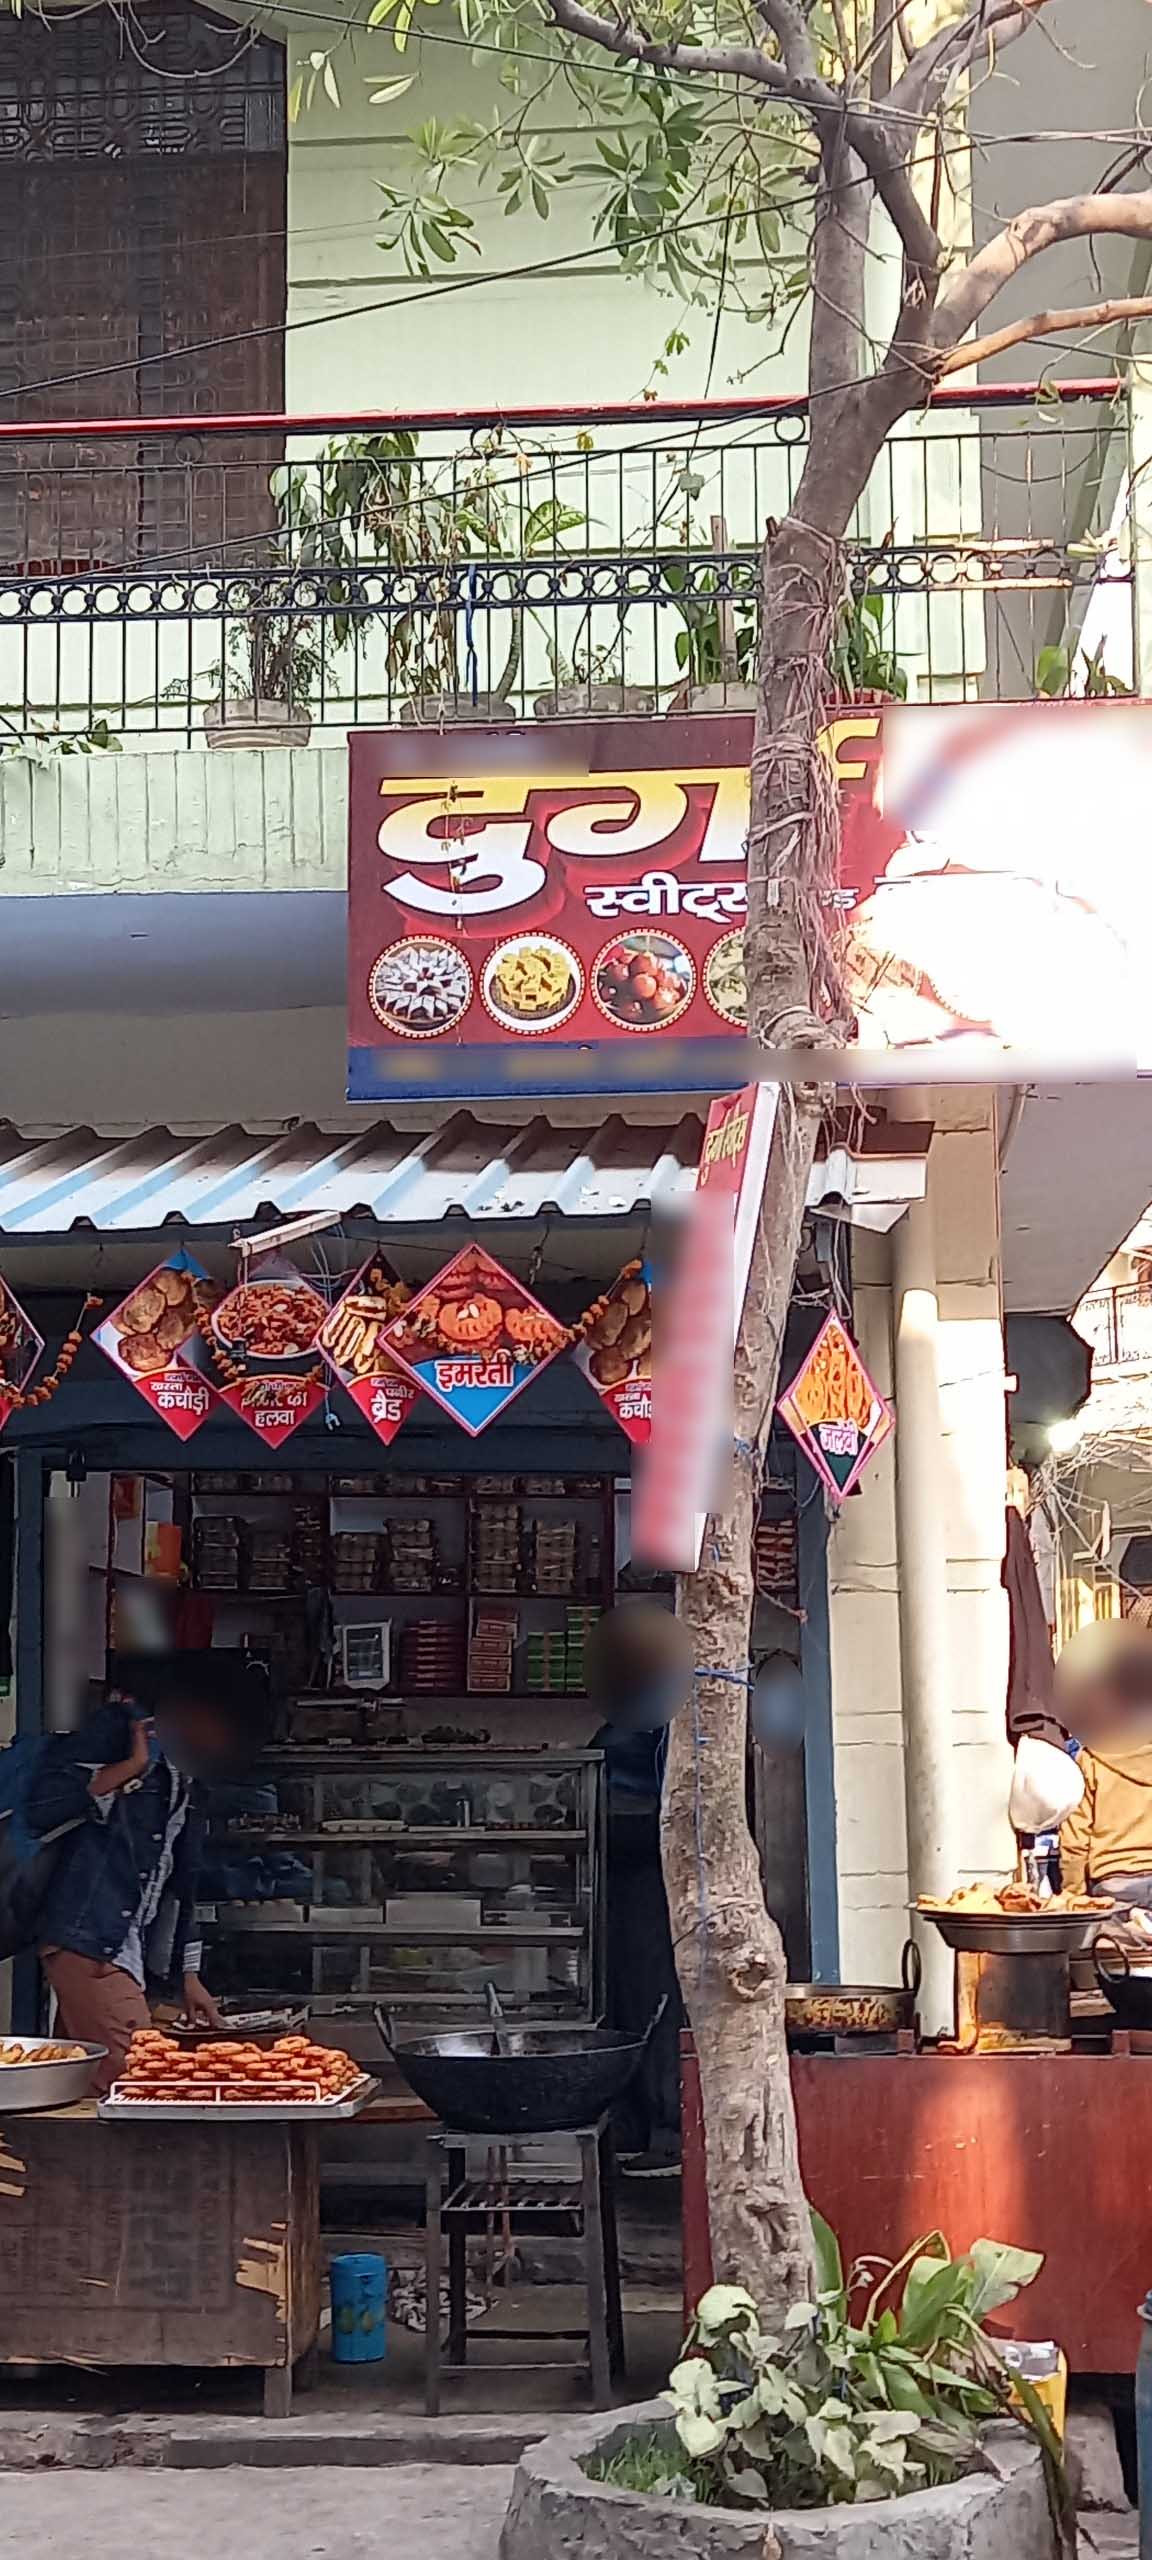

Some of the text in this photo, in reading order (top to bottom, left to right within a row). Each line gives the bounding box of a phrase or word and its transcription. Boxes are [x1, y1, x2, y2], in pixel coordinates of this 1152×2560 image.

[378, 717, 881, 915] दुर्ग
[434, 1348, 515, 1392] इमरती
[156, 1385, 210, 1416] कचौड़ी
[254, 1409, 295, 1428] हलवा
